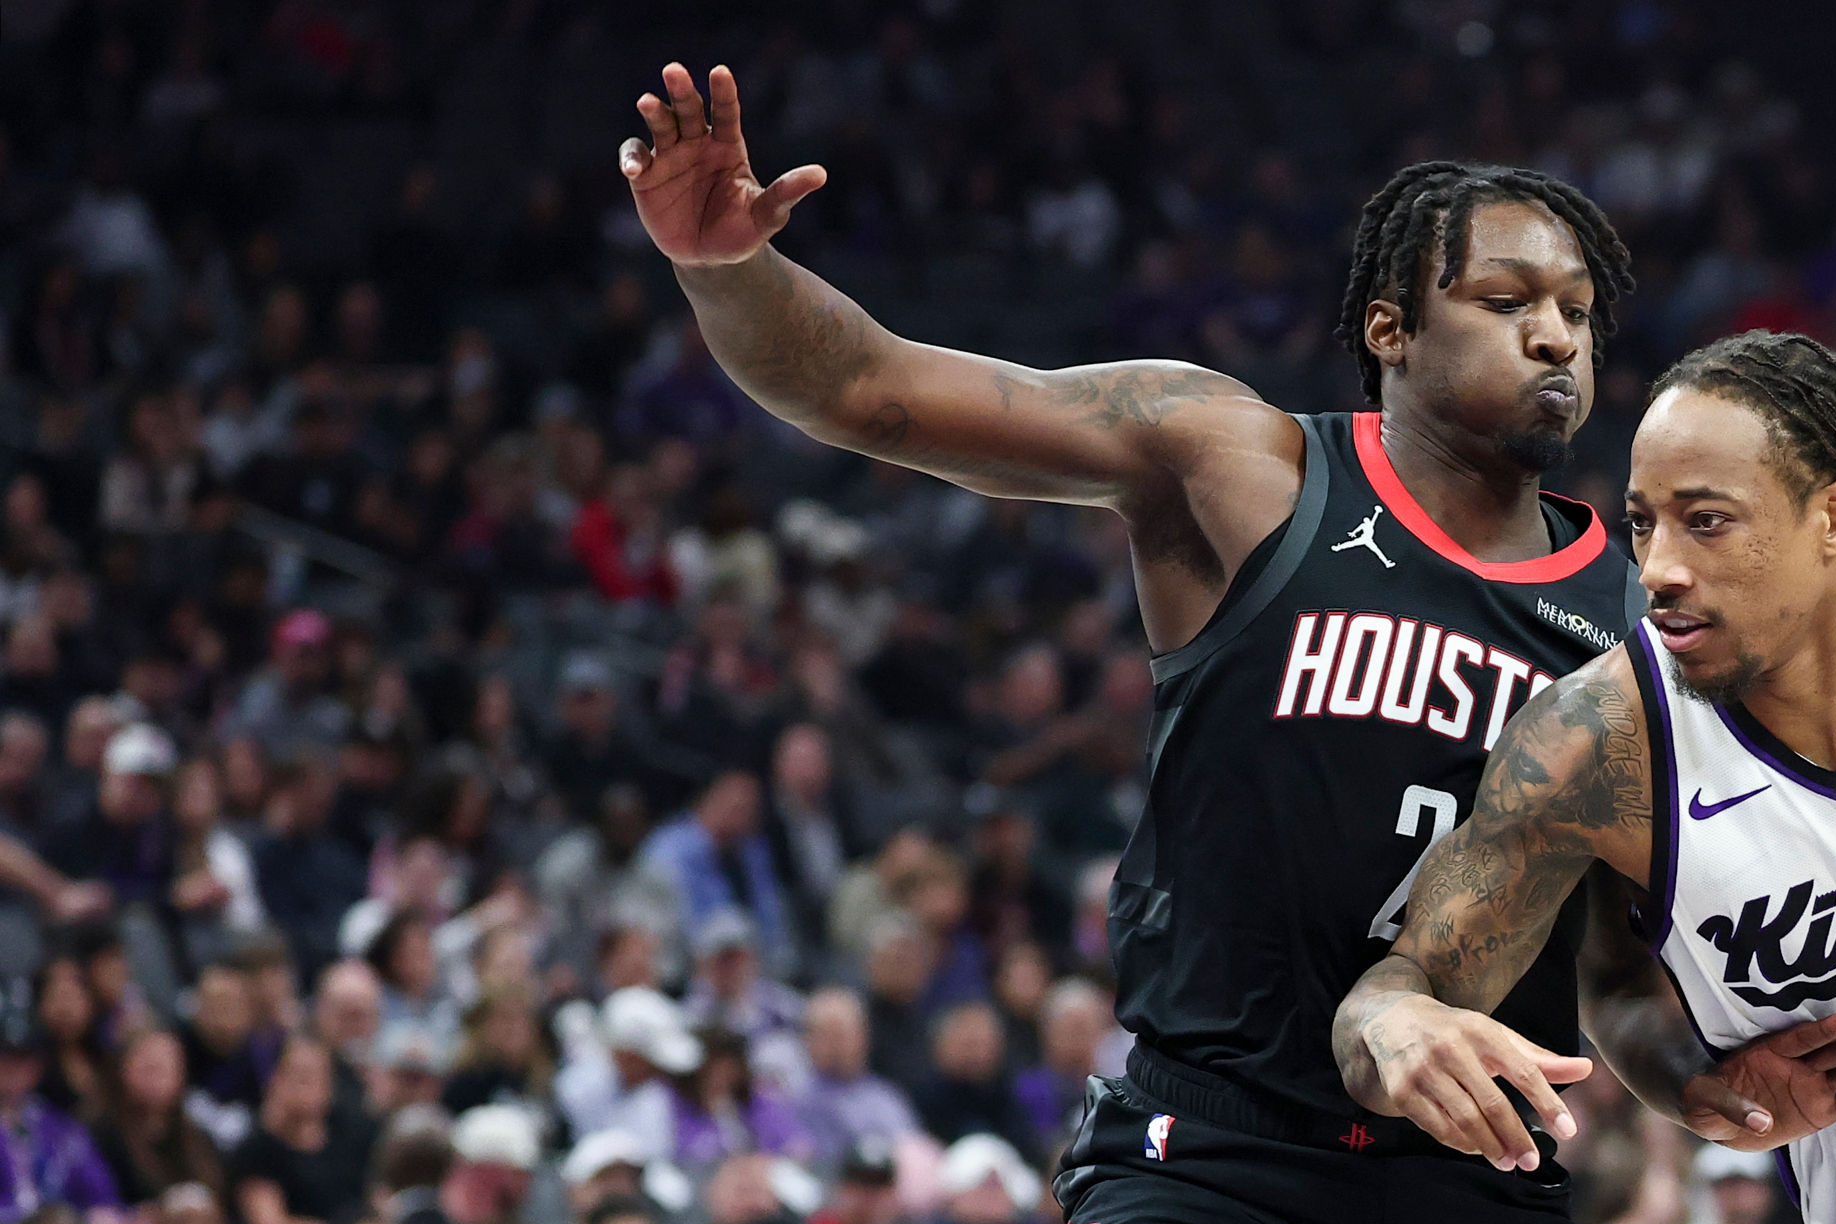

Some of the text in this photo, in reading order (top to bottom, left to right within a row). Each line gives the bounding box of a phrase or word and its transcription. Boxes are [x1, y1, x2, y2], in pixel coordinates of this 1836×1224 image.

[1537, 597, 1618, 643] MEMORIAL
[1537, 604, 1617, 649] HERMANN
[1274, 610, 1556, 752] HOUST
